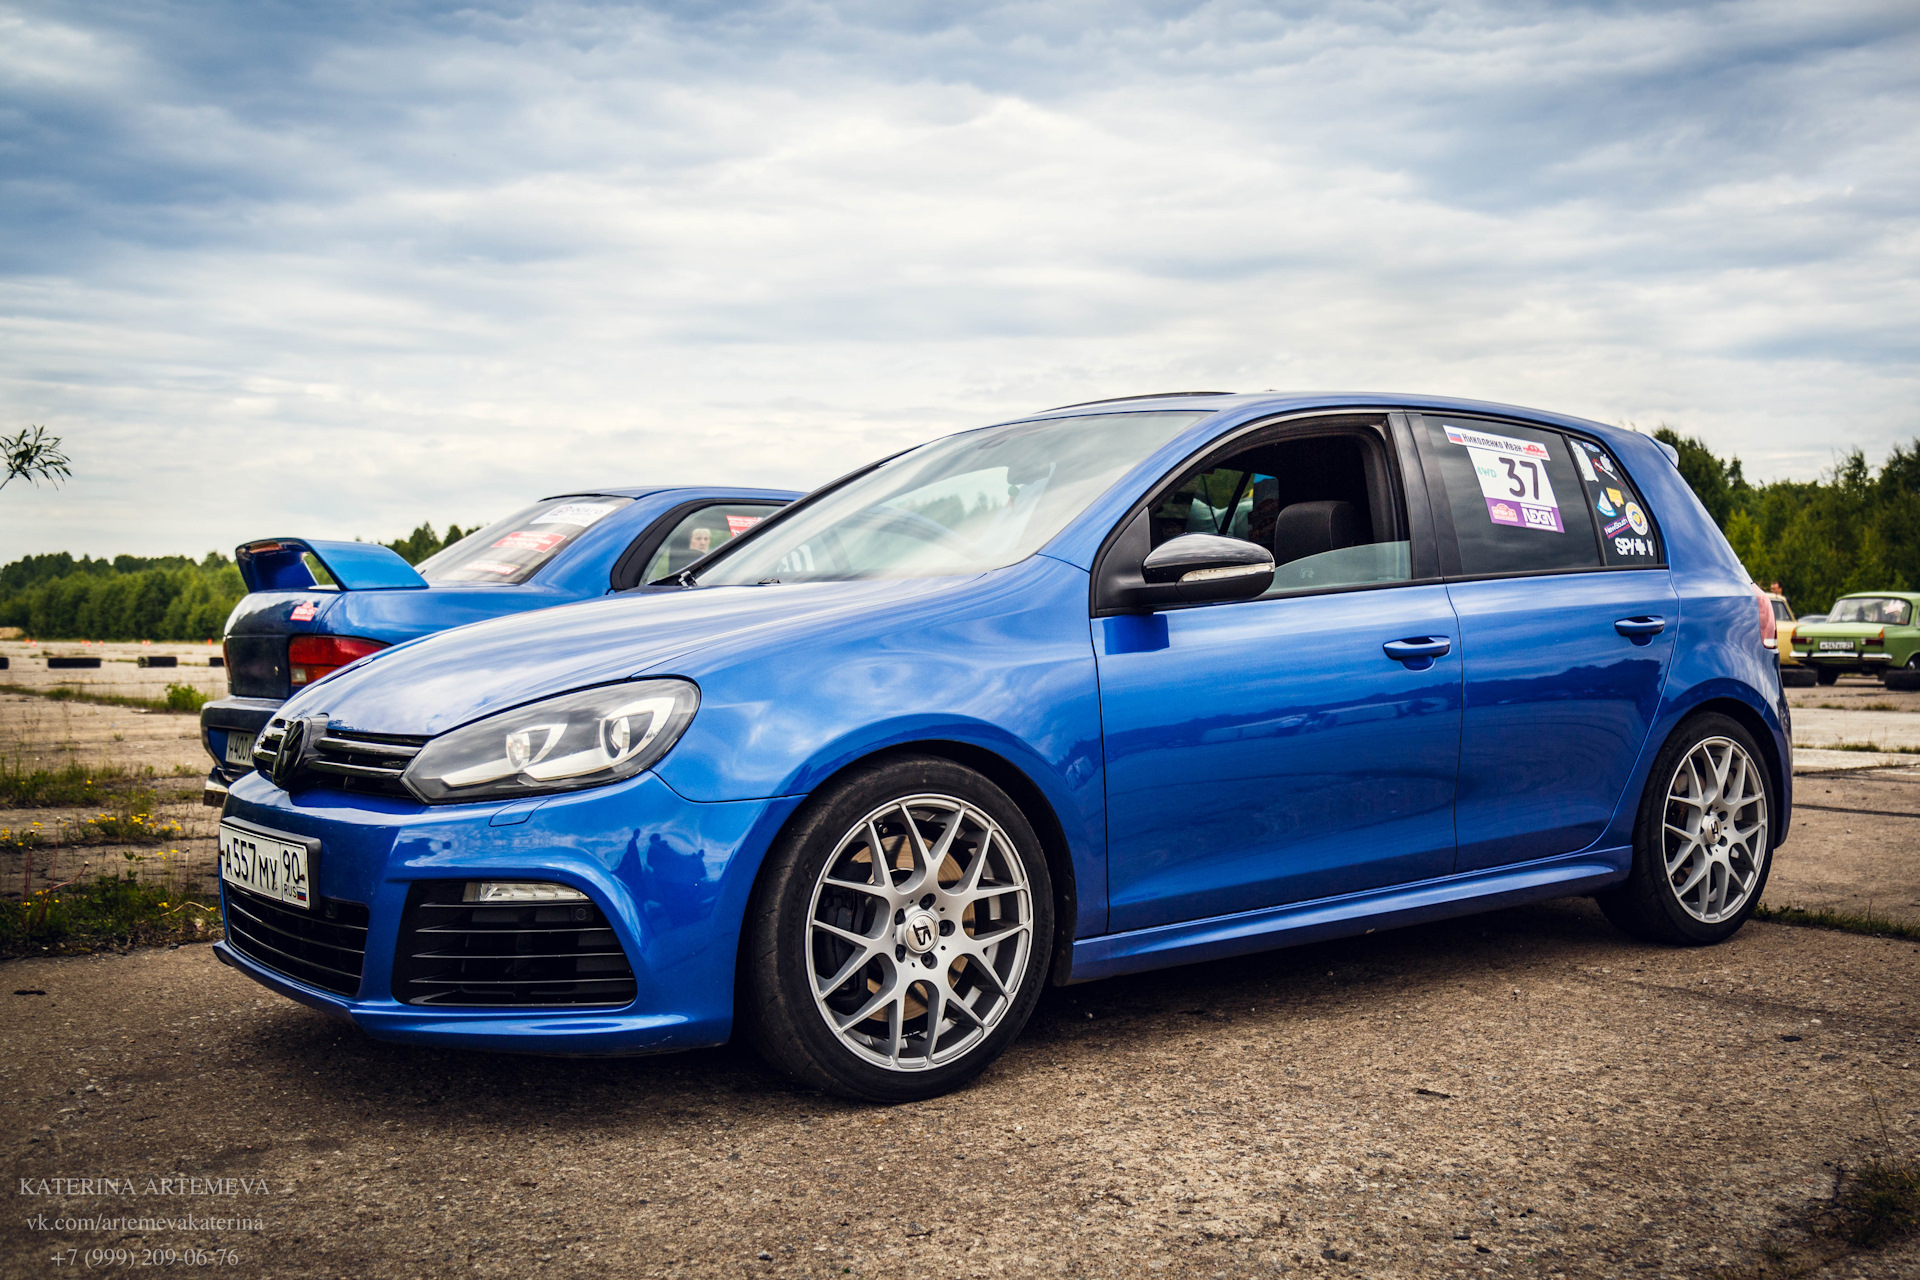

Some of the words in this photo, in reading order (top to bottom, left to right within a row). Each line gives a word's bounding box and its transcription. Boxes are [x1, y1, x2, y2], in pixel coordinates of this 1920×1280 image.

[1503, 441, 1523, 452] Иван
[1499, 457, 1540, 500] 37
[283, 849, 300, 884] 90
[284, 883, 297, 898] RUS
